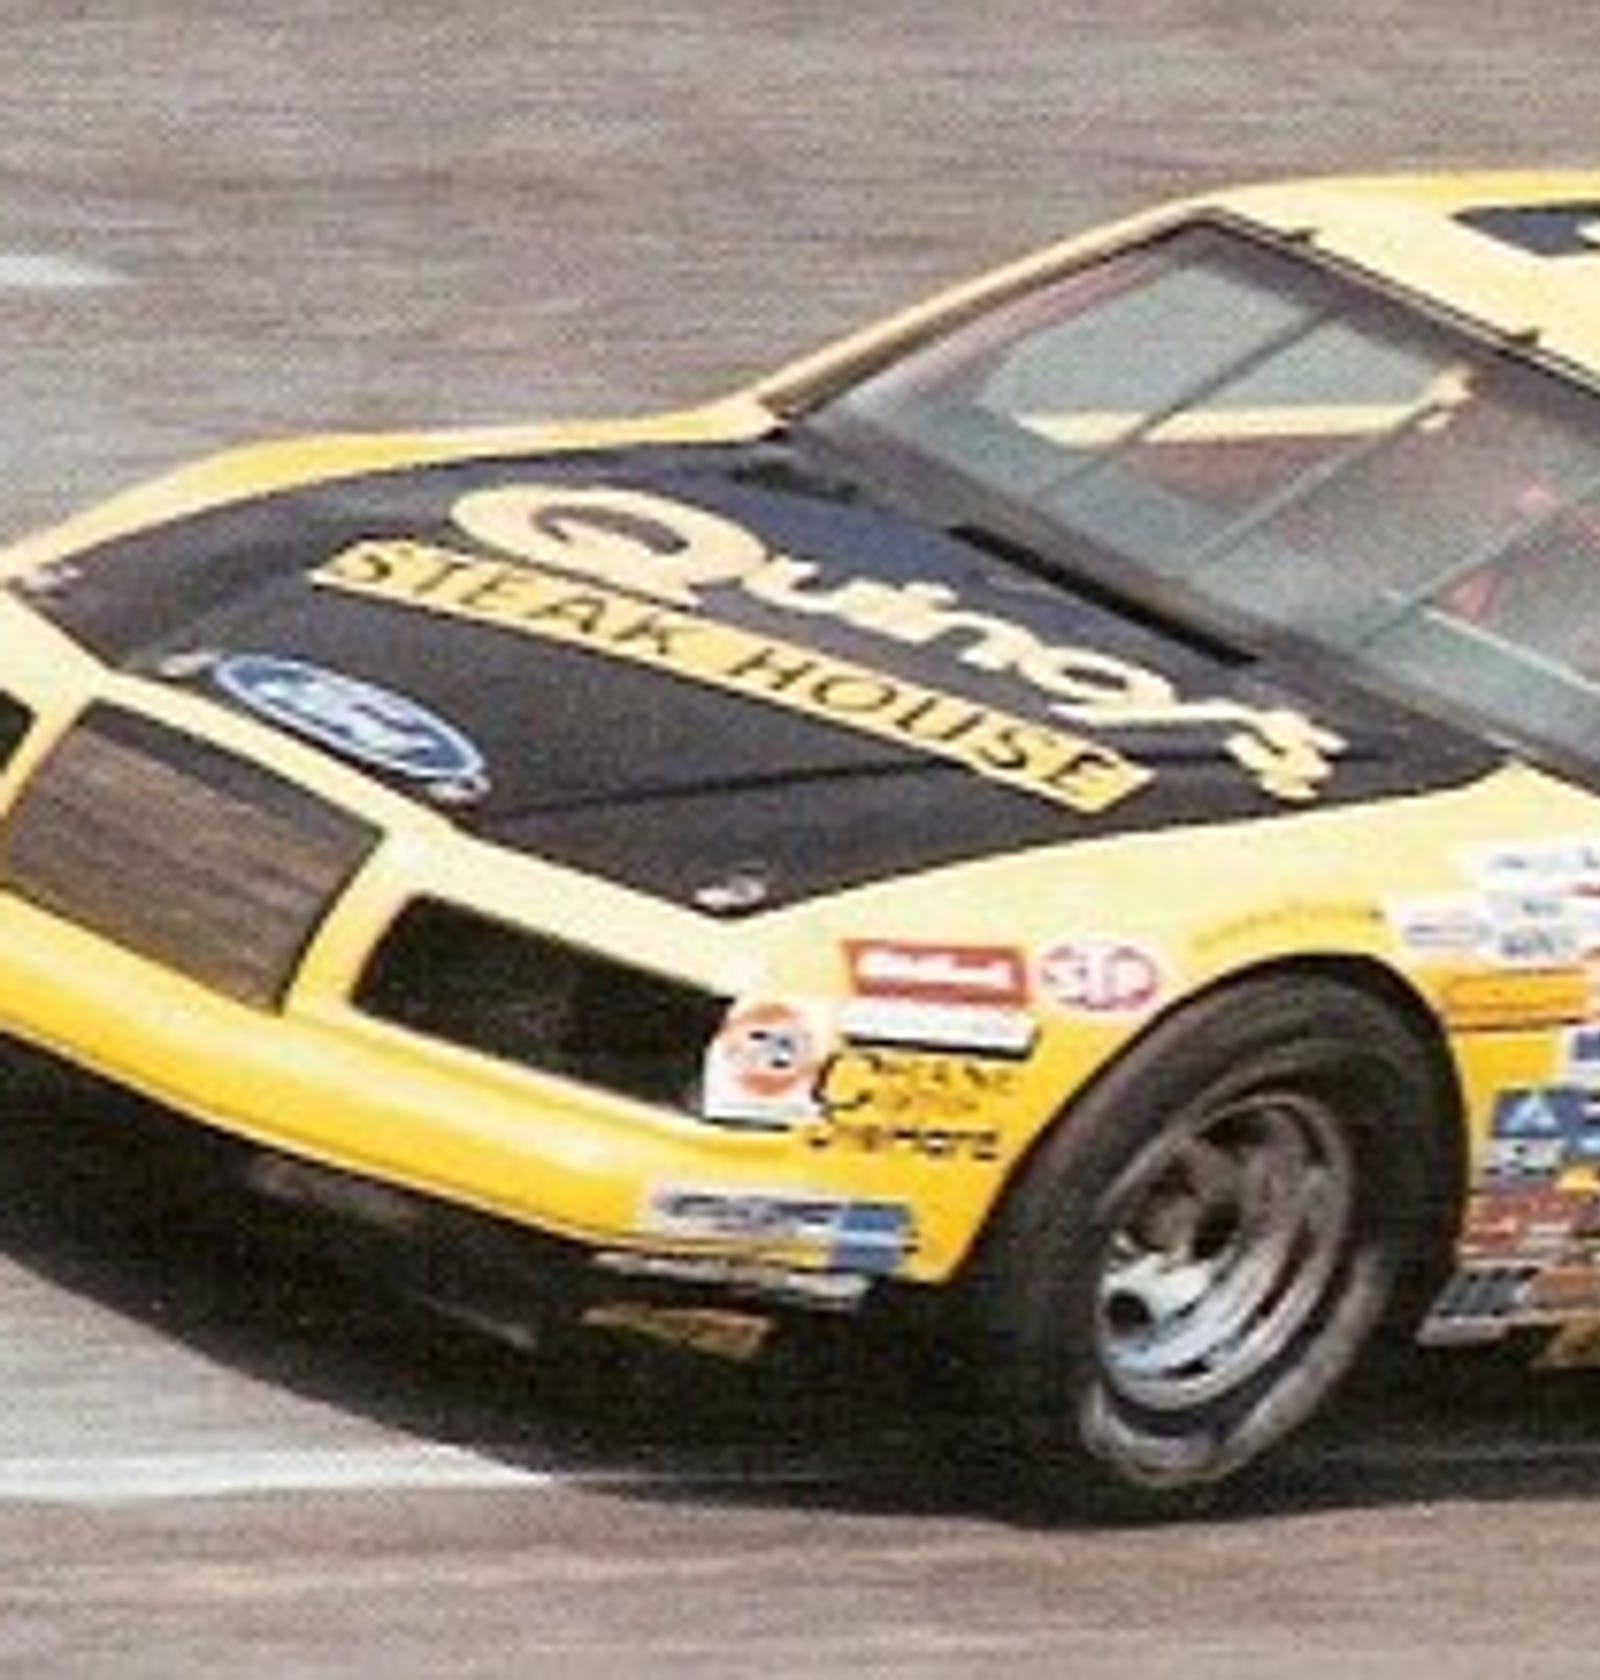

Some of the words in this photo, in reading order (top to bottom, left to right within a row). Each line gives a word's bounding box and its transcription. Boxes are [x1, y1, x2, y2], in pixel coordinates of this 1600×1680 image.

[355, 540, 696, 657] STEAK
[724, 644, 1118, 800] HOUSE
[449, 484, 1347, 800] Quincy's
[1038, 944, 1162, 1012] STP
